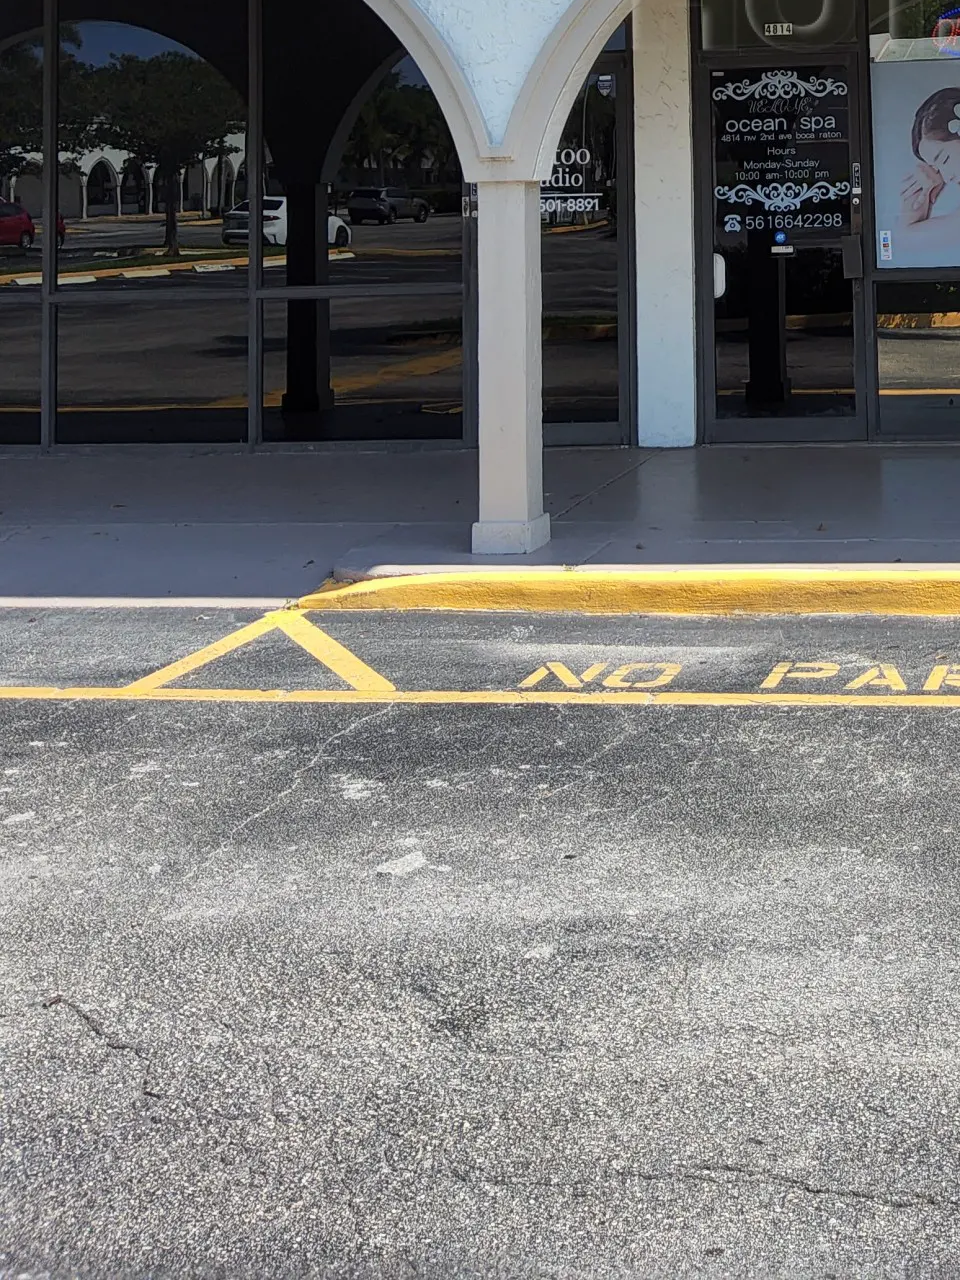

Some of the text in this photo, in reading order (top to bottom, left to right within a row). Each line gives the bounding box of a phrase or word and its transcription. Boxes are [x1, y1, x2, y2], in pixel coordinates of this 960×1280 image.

[765, 23, 792, 35] 4814
[725, 115, 836, 133] ocean spa
[721, 134, 741, 143] 4814
[744, 134, 757, 142] nw
[760, 133, 775, 141] 2nd
[795, 131, 815, 140] boca
[819, 130, 842, 139] raton
[767, 146, 796, 156] Hours
[743, 158, 820, 171] Monday-Sunday
[735, 172, 760, 181] 10:00
[815, 170, 830, 180] pm
[745, 213, 843, 230] 5616642298
[517, 662, 682, 689] NO
